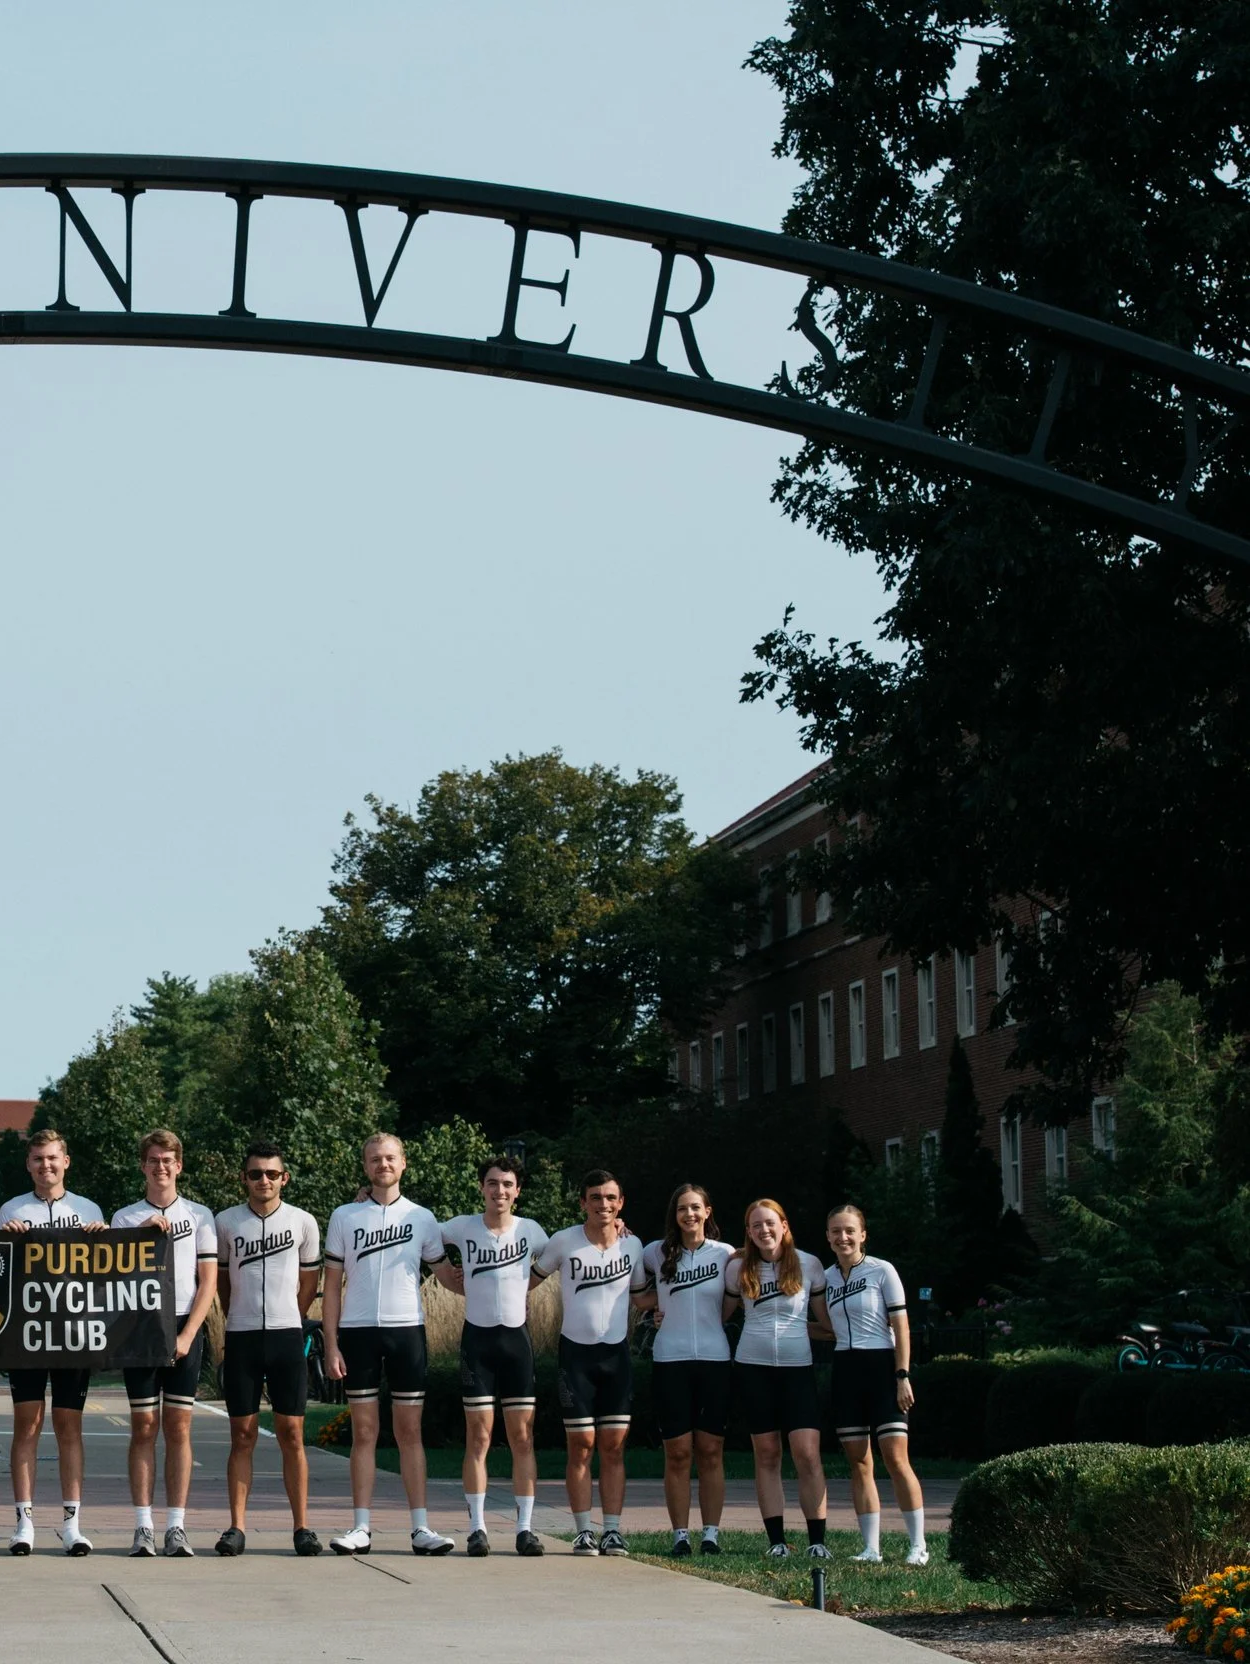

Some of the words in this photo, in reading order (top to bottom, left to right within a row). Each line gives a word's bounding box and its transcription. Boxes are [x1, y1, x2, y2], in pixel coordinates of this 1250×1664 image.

[234, 1229, 294, 1258] Purdue
[353, 1223, 413, 1251] Purdue
[466, 1237, 528, 1265] Purdue
[24, 1241, 156, 1274] PURDUE
[570, 1254, 631, 1281] Purdue
[660, 1262, 719, 1285] urdue
[23, 1279, 162, 1313] CYCLING
[827, 1277, 866, 1301] Purdue
[23, 1320, 107, 1352] CLUB
